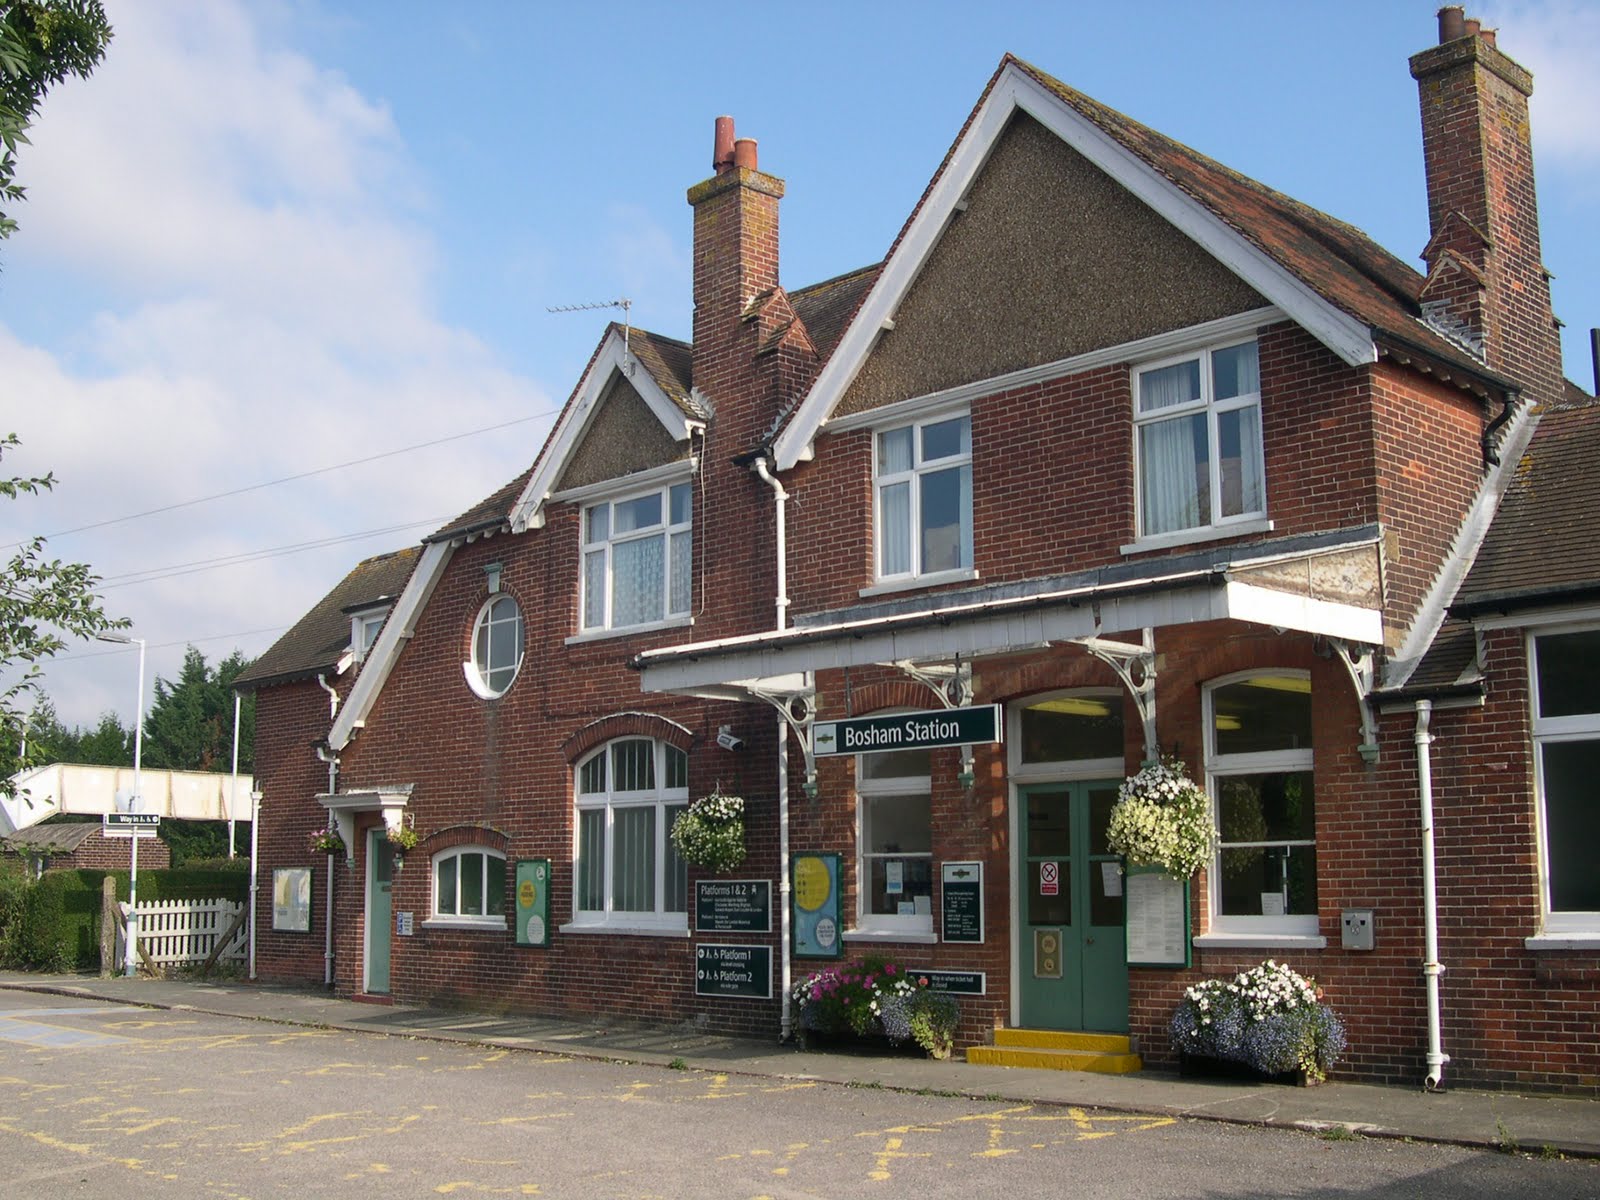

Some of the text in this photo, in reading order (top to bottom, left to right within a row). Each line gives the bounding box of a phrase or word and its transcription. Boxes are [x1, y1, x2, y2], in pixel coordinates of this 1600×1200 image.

[845, 718, 960, 747] Bosham Station
[120, 815, 133, 824] Way
[701, 884, 731, 895] Platforms
[735, 884, 741, 895] &
[741, 884, 747, 895] 2
[720, 949, 747, 960] Platform
[720, 970, 753, 982] Platform 2
